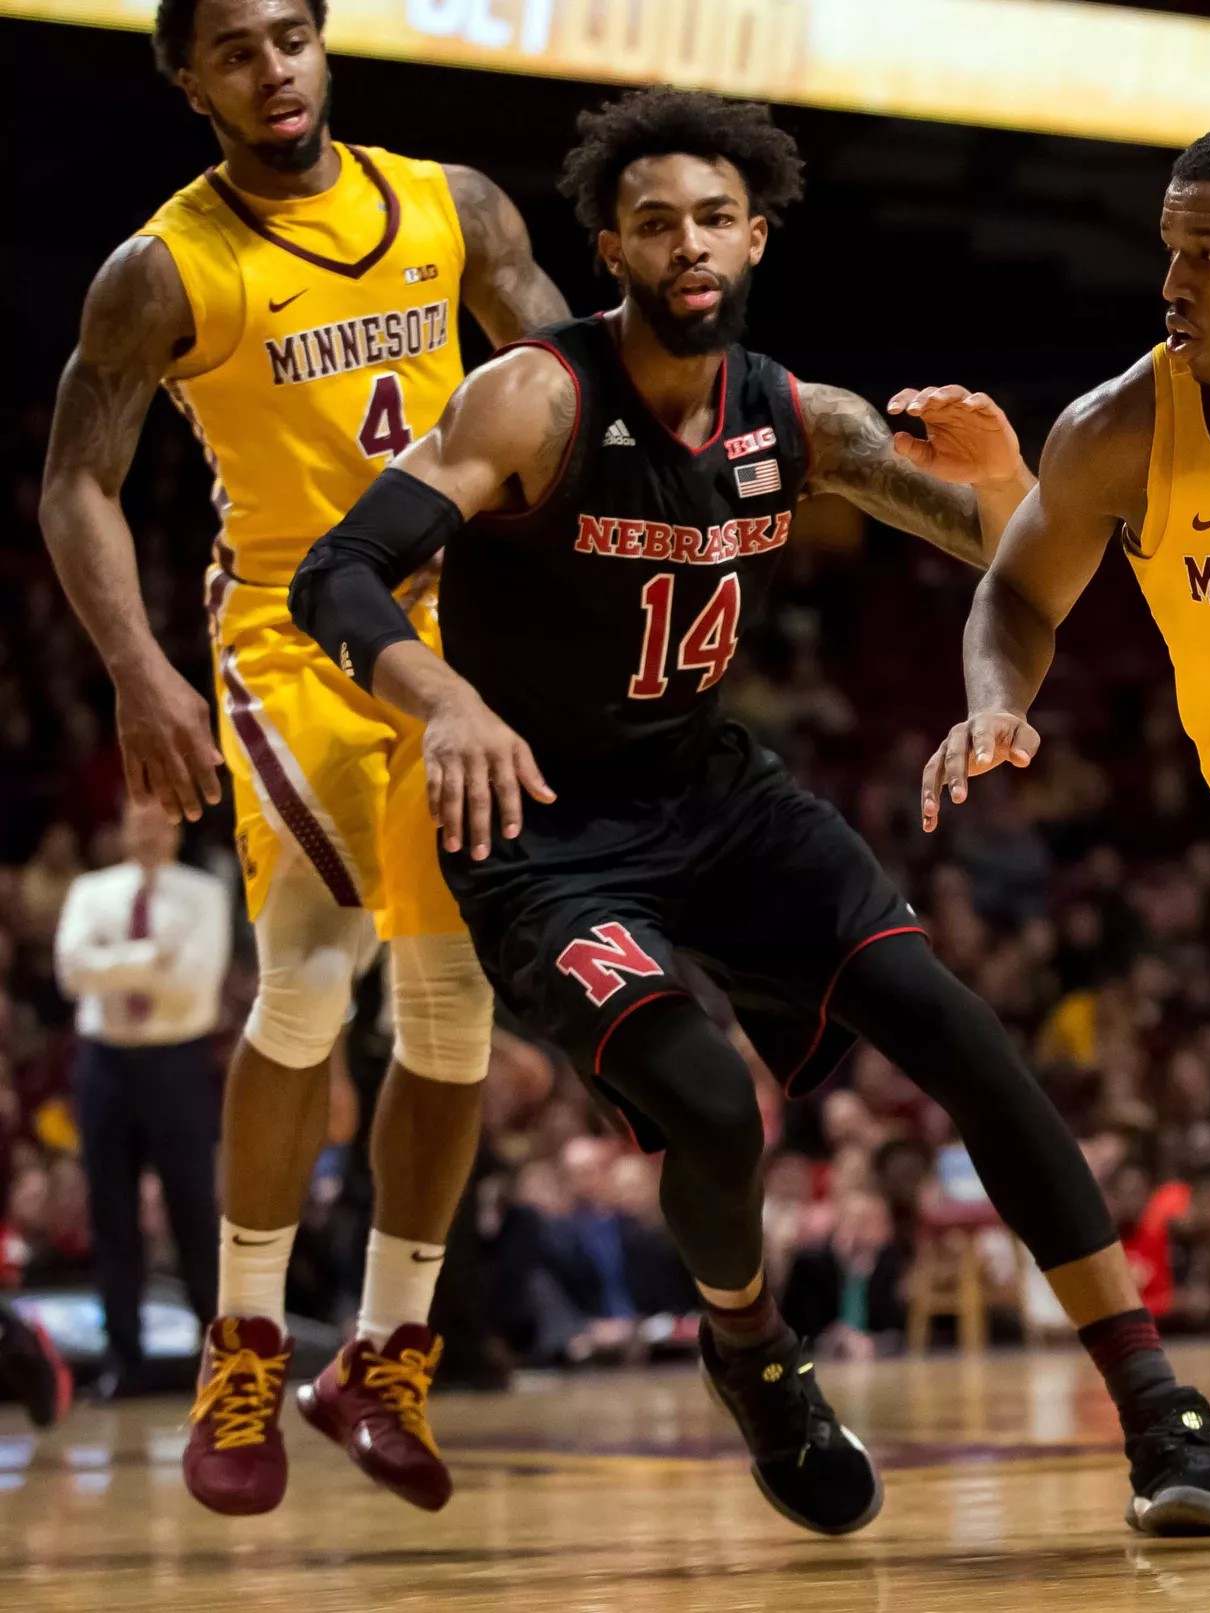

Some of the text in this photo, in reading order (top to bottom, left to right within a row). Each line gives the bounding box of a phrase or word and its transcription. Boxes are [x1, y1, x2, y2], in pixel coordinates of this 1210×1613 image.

[355, 371, 414, 464] 4
[575, 511, 792, 565] NEBRASKA
[628, 572, 741, 699] 14
[556, 921, 665, 1008] N
